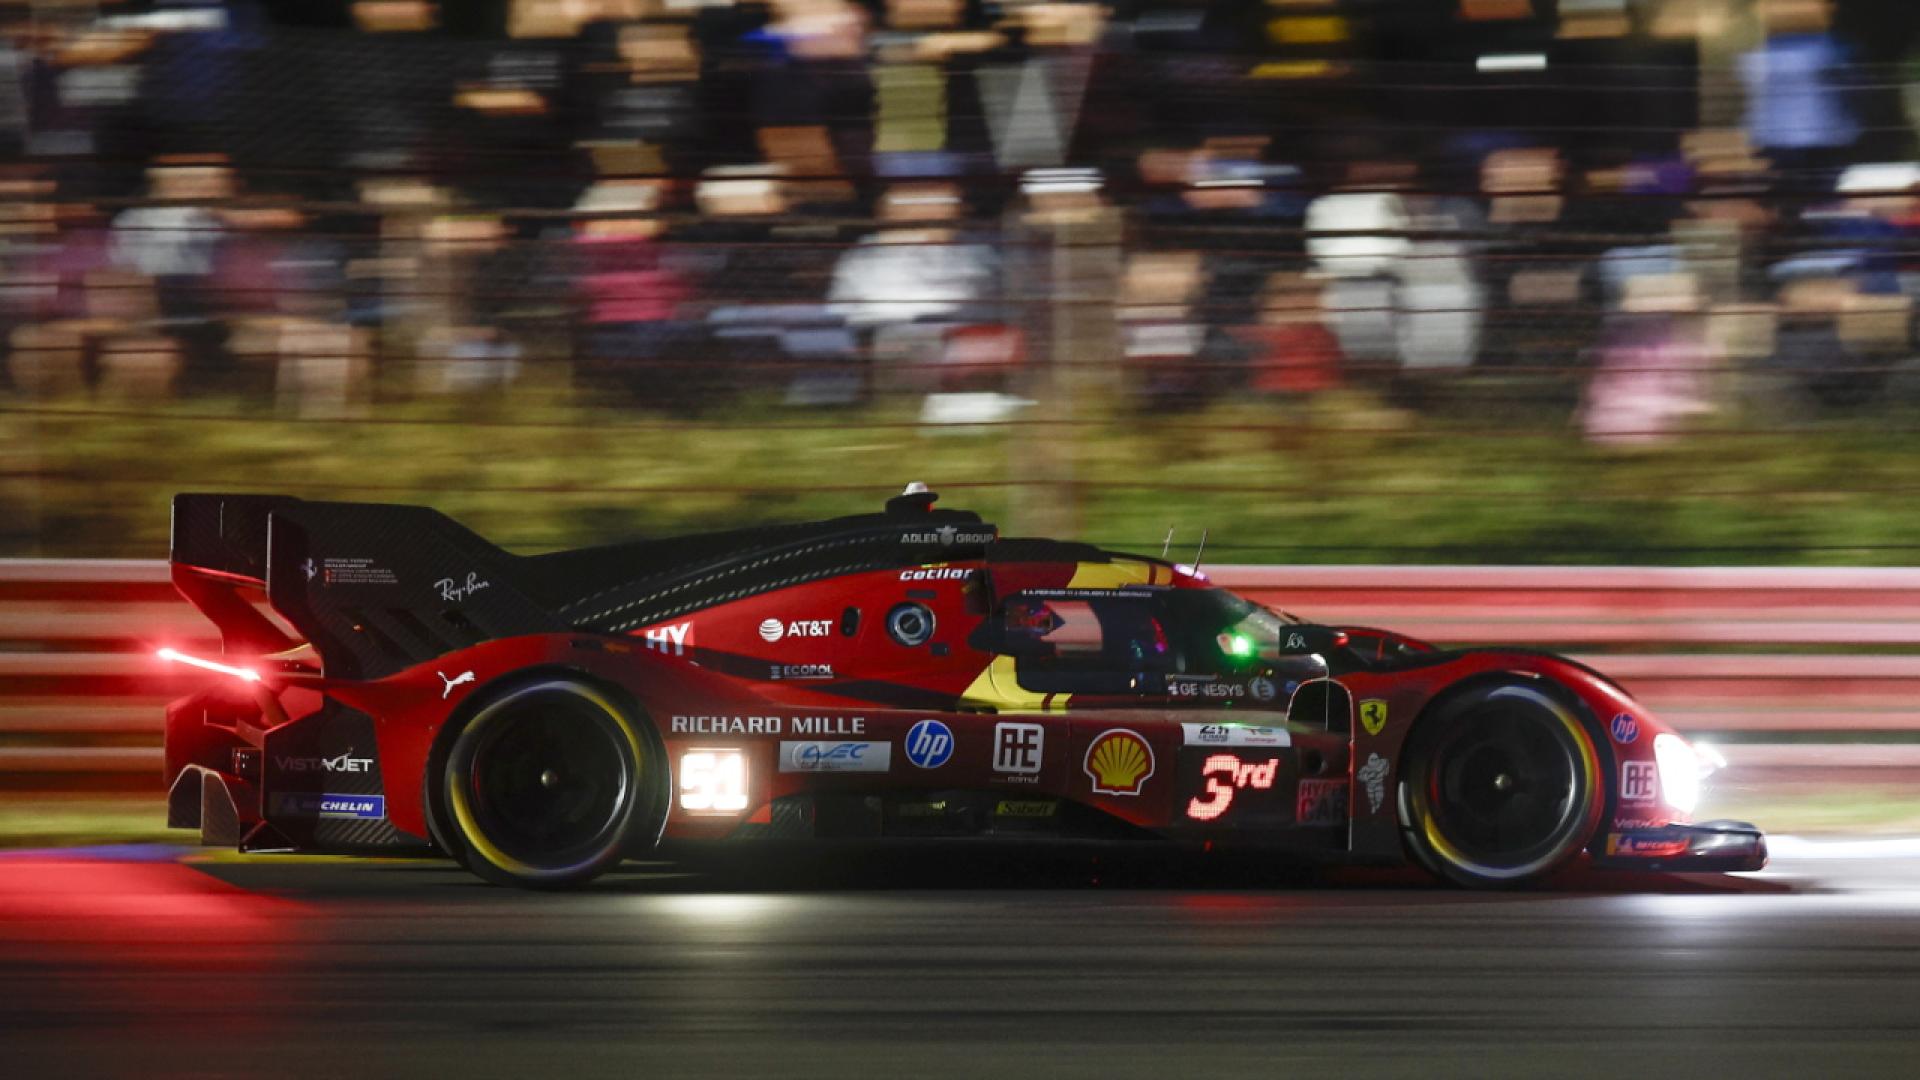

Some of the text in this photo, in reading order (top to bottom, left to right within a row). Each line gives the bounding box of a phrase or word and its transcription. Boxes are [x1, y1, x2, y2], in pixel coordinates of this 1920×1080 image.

[901, 533, 994, 544] ADLER GROUP
[787, 620, 833, 636] AT&T
[646, 621, 691, 656] HY
[784, 664, 832, 675] ECOPOL
[671, 716, 866, 734] RICHARD MILLE
[1613, 713, 1637, 744] hp
[911, 721, 948, 767] hp
[1187, 755, 1279, 820] 3rd
[303, 801, 374, 812] CHELIN
